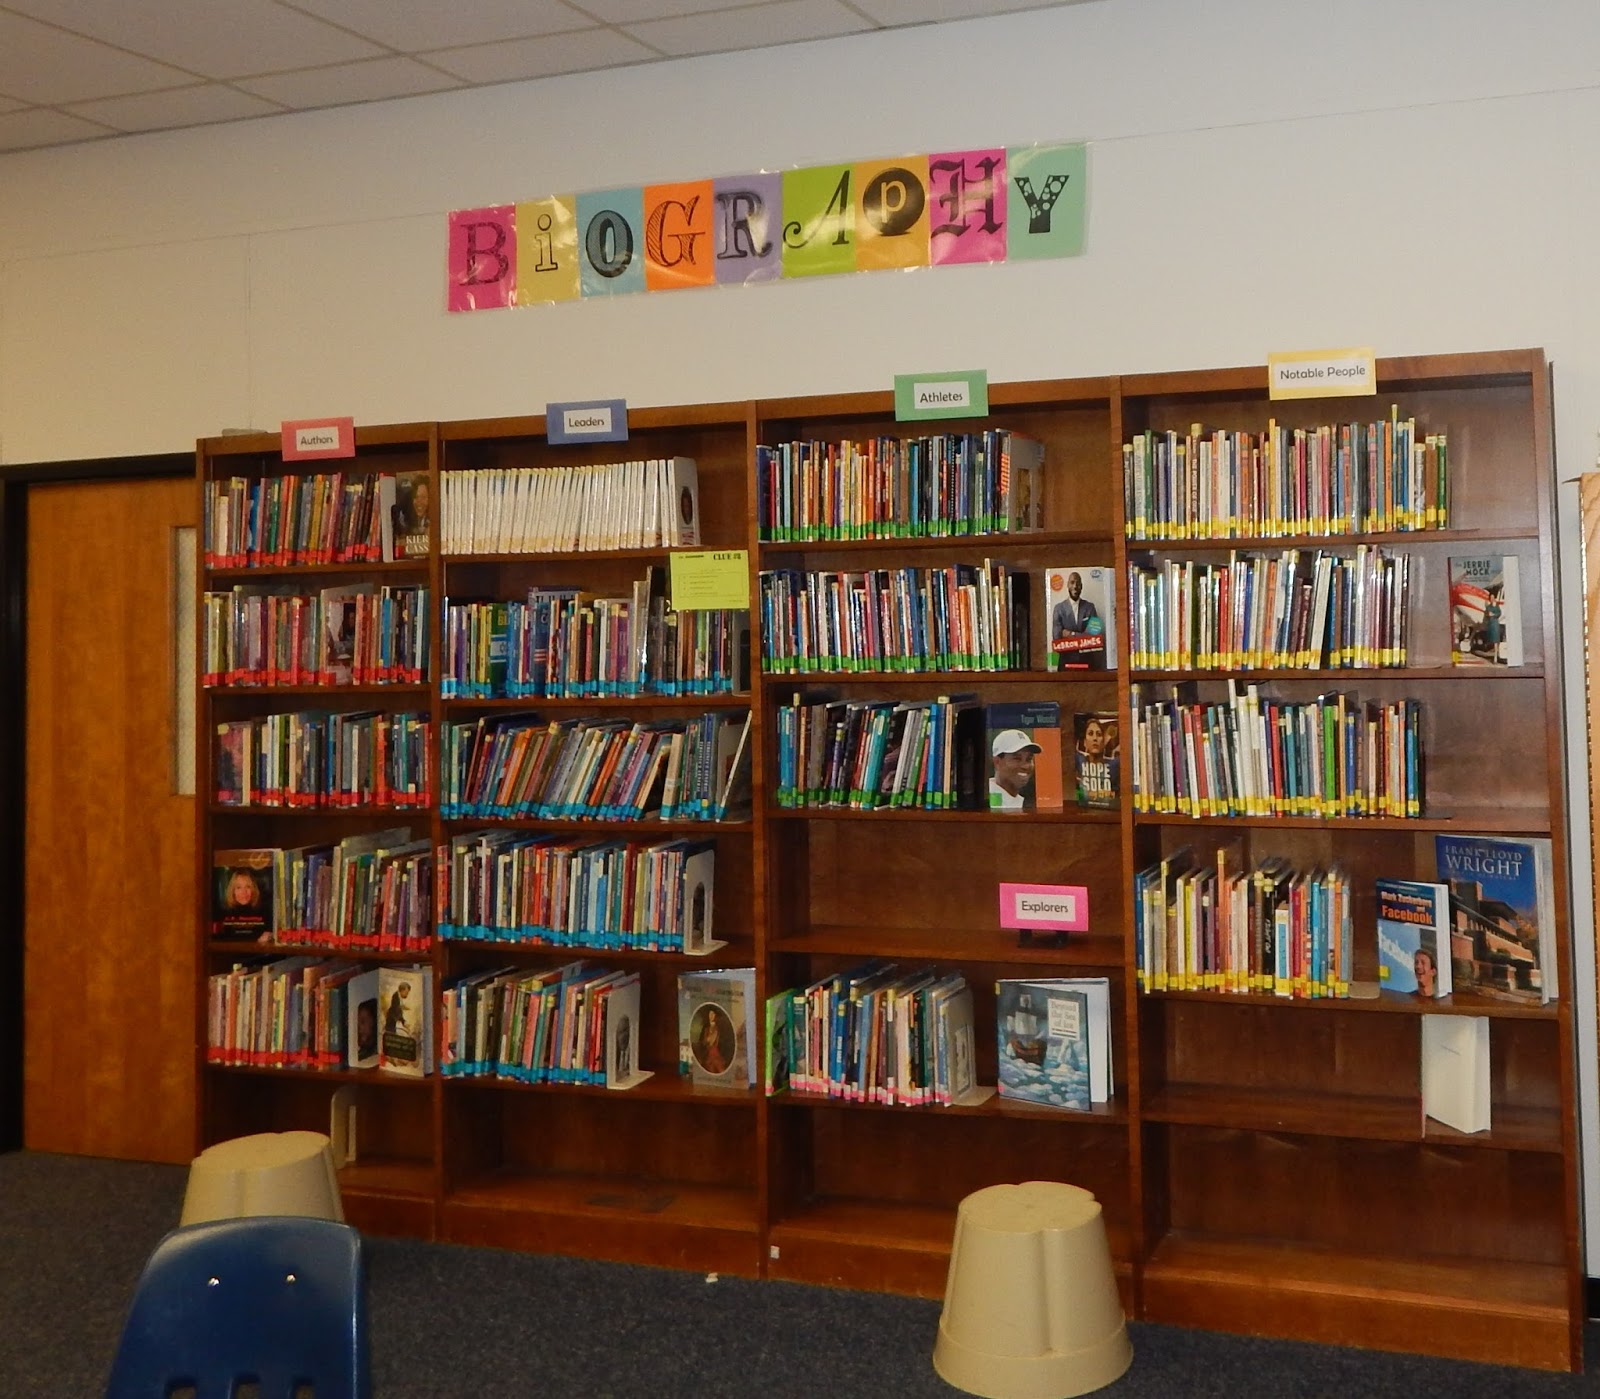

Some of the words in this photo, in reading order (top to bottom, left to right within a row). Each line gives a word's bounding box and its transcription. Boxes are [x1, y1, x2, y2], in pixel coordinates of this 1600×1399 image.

[1280, 367, 1324, 379] Notable
[1327, 365, 1366, 377] People
[920, 391, 963, 403] Athletes
[568, 416, 605, 427] Leaders
[300, 435, 334, 446] Authors
[1081, 762, 1111, 778] HOPE
[1082, 776, 1112, 792] SOLO
[1445, 854, 1522, 876] WRIGHT
[1021, 901, 1068, 913] Explorers
[1381, 904, 1433, 925] Facebook
